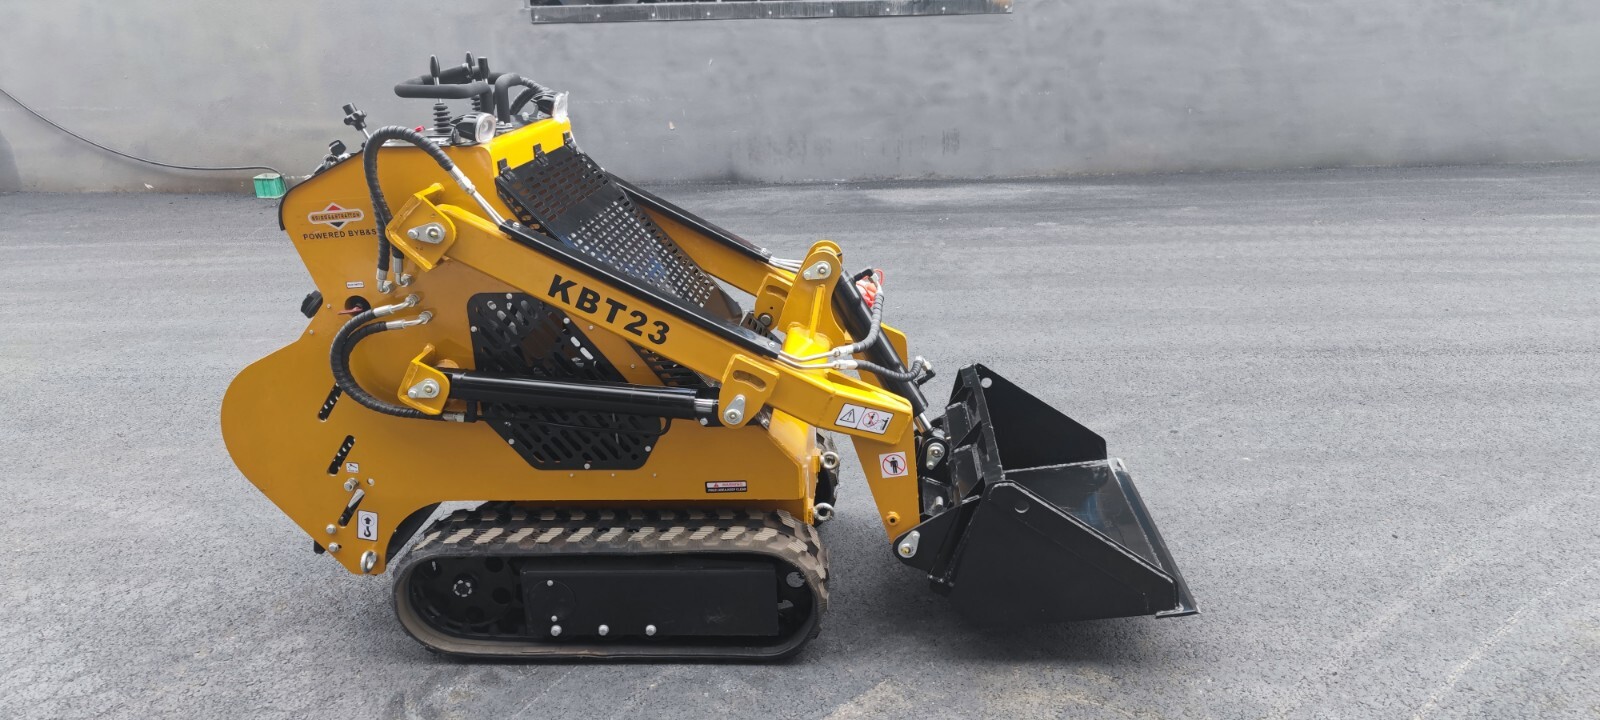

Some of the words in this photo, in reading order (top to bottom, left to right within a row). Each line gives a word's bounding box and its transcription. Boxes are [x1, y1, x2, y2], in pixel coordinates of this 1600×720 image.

[303, 231, 346, 240] POWERED
[348, 228, 377, 237] BYB&S
[547, 274, 670, 345] KBT23
